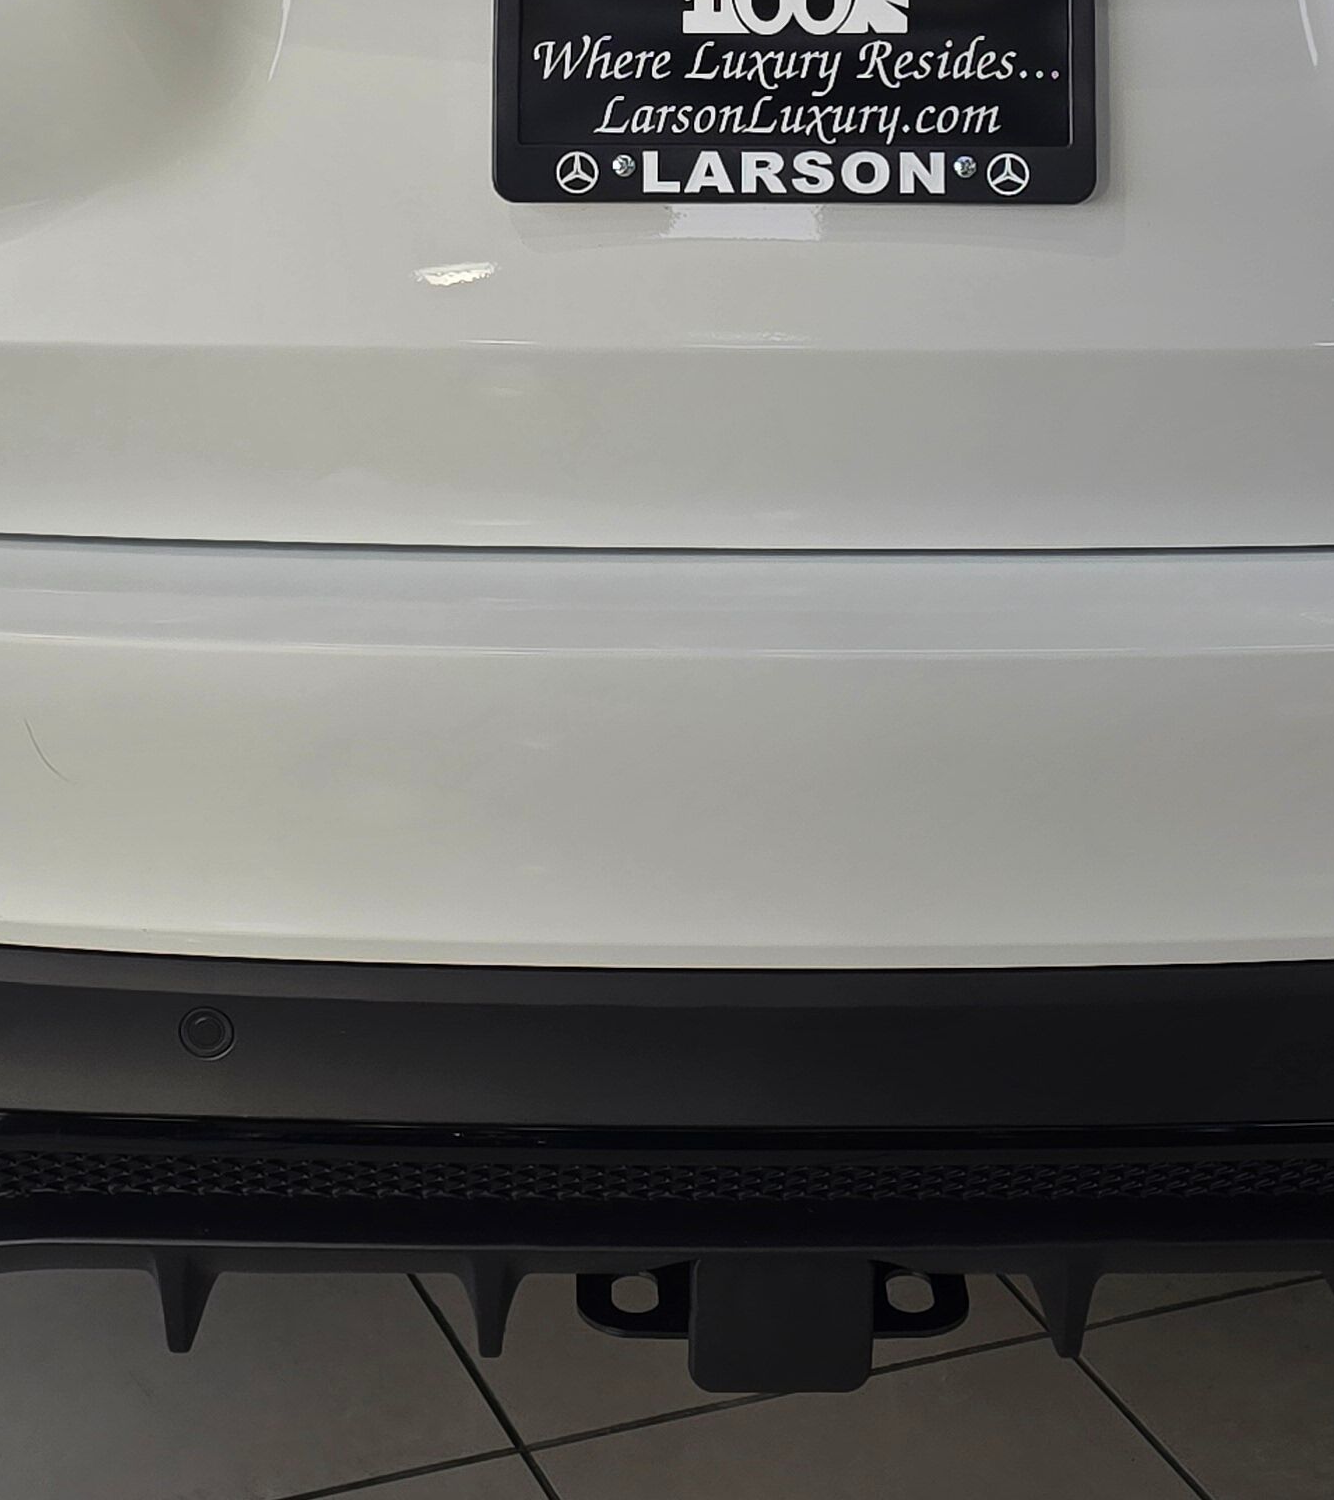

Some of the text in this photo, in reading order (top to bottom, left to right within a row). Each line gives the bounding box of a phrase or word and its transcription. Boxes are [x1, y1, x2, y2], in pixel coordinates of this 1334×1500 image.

[533, 35, 1061, 97] Where Luxury Resides...
[593, 95, 1003, 144] LarsonLuxury.com
[642, 150, 947, 195] LARSON
